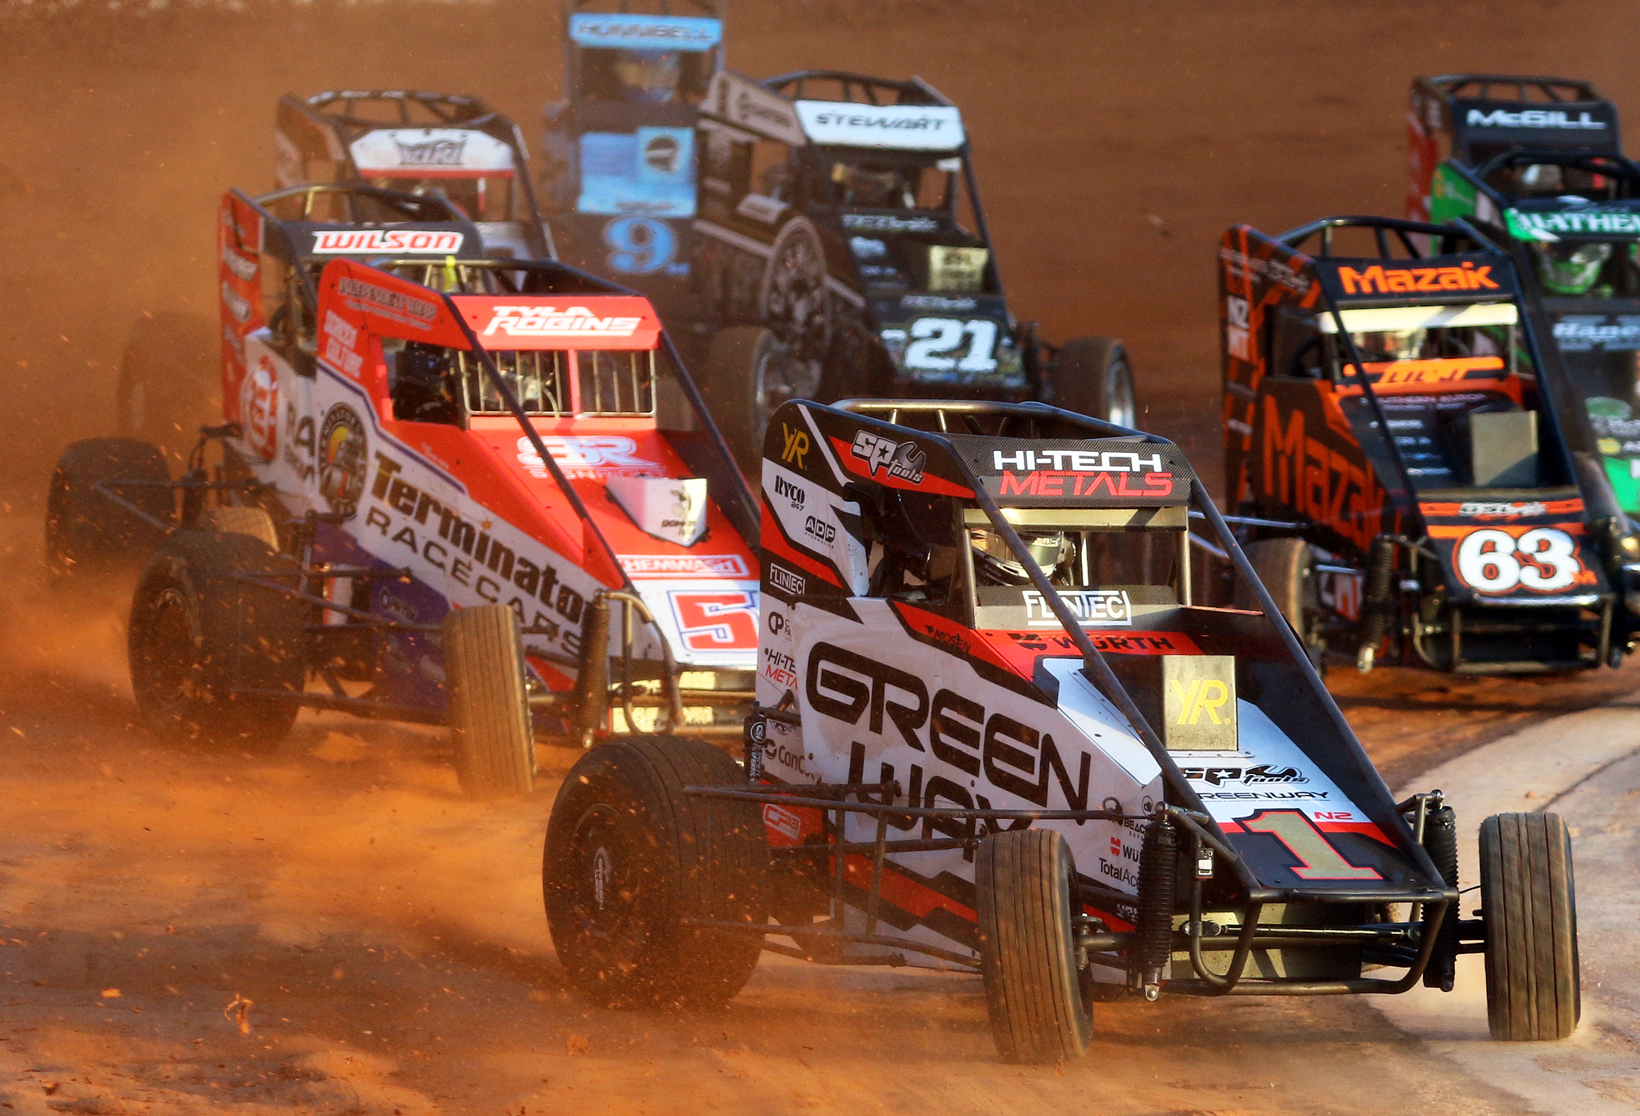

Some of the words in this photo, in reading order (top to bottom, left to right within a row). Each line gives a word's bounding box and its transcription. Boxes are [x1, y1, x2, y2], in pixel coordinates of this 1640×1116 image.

[815, 113, 947, 131] STEWART
[1467, 109, 1607, 130] McGILL
[318, 232, 460, 251] WILSON
[603, 214, 678, 276] 9
[1337, 261, 1499, 294] Mazak
[492, 305, 595, 317] TYLA
[483, 316, 641, 336] ROBINS
[905, 317, 997, 372] 21
[993, 450, 1162, 473] HI-TECH
[774, 475, 806, 505] RYCO
[999, 471, 1173, 497] METALS
[366, 449, 597, 625] Terminato
[805, 515, 836, 543] ADP
[1458, 528, 1581, 592] 63
[668, 590, 758, 652] 5
[806, 641, 1092, 826] GREEN
[1196, 791, 1328, 800] REENWAY
[1240, 810, 1384, 881] 1
